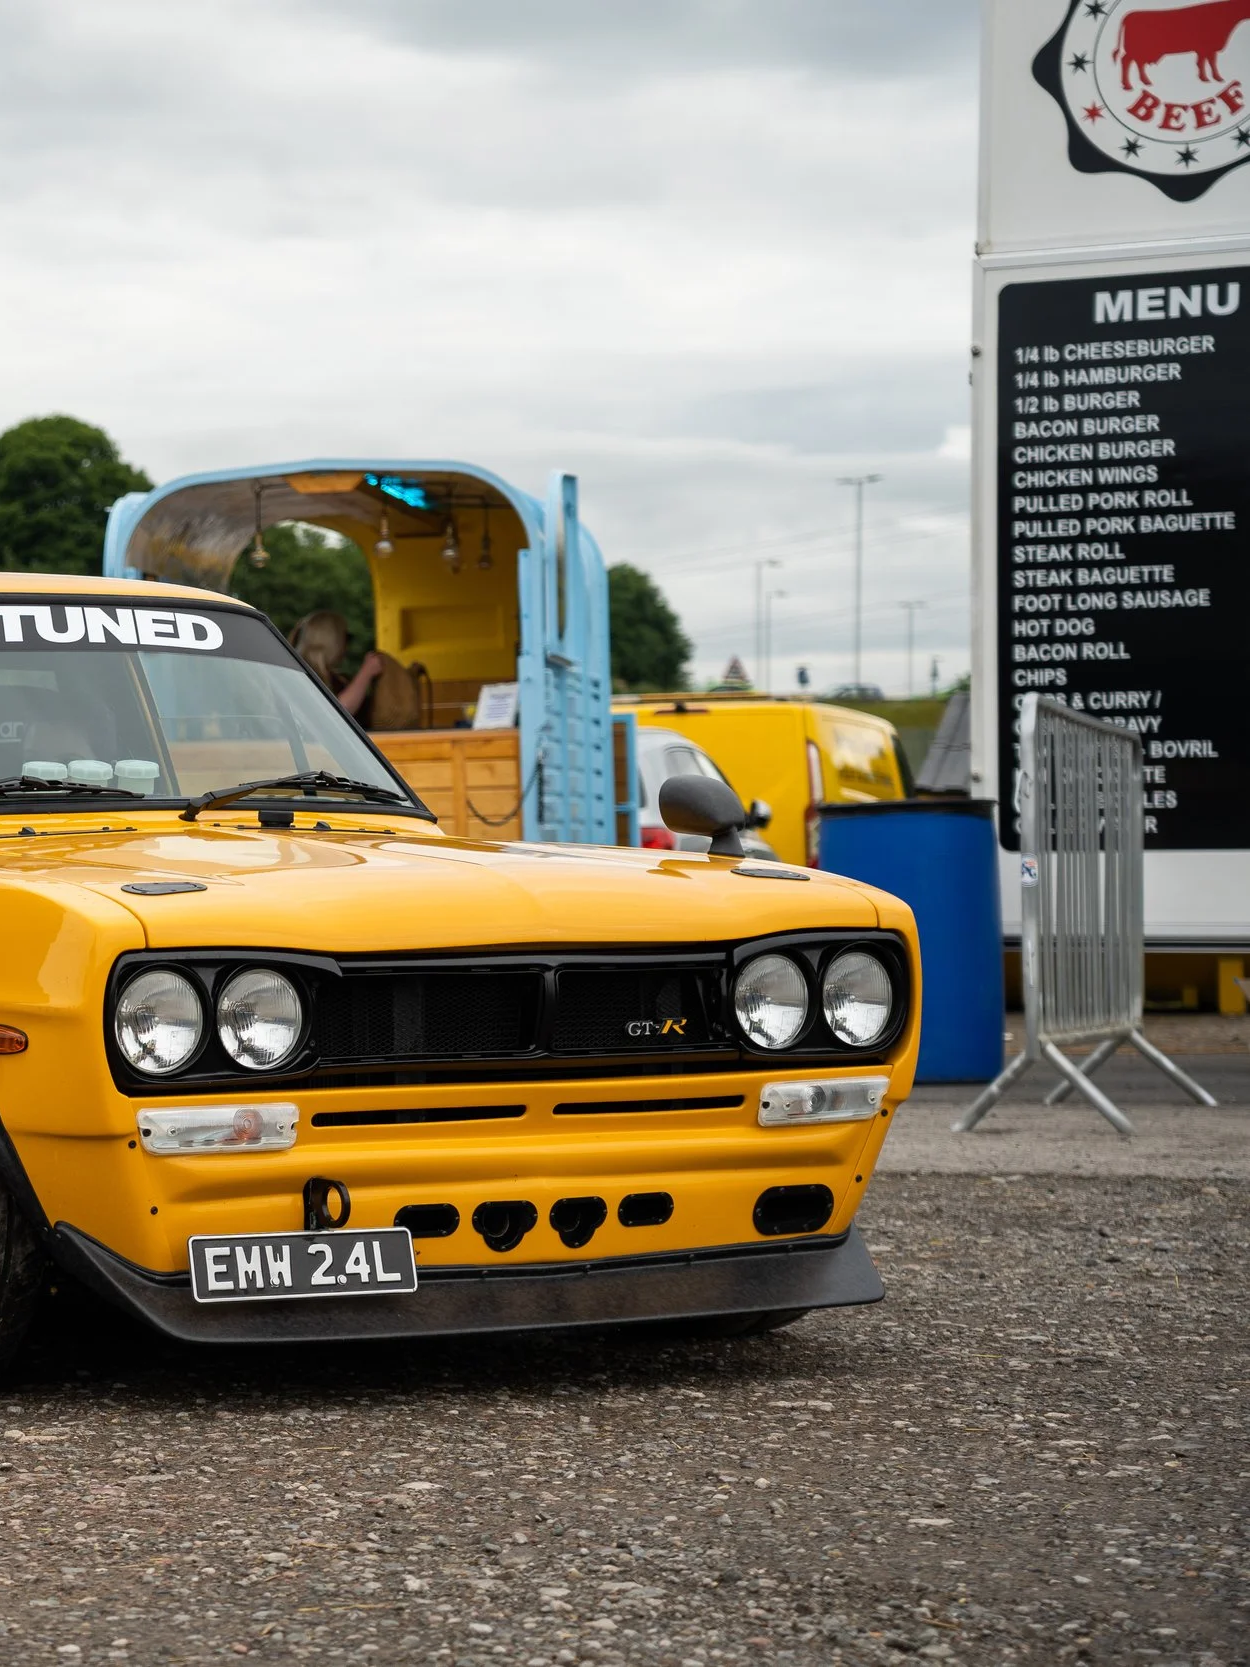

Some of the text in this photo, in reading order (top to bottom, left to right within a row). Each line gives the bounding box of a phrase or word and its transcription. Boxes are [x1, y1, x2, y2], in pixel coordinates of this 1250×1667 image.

[1126, 80, 1247, 132] BEEF
[1094, 282, 1240, 323] MENU
[1015, 335, 1215, 364] 1/4 lb CHEESEBURGER
[1015, 363, 1182, 389] 1/4 lb HAMBURGER
[1015, 390, 1140, 414] 1/2 lb BURGER
[1014, 415, 1160, 439] BACON BURGER
[1014, 439, 1176, 464] CHICKEN BURGER
[1014, 465, 1158, 488] CHICKEN WINGS
[1014, 489, 1193, 513] PULLED PORK ROLL
[1013, 511, 1235, 538] PULLED PORK BAGUETTE
[1013, 542, 1125, 563] STEAK ROLL
[1013, 565, 1175, 588] STEAK BAGUETTE
[1013, 588, 1211, 612] FOOT LONG SAUSAGE
[1013, 618, 1095, 637] HOT DOG
[1013, 642, 1130, 662] BACON ROLL
[1013, 668, 1067, 687] CHIPS
[1072, 692, 1085, 709] &
[1090, 691, 1152, 709] CURRY
[1151, 740, 1218, 758] BOVRIL
[628, 1019, 688, 1036] GT-R
[205, 1245, 293, 1291] EMW
